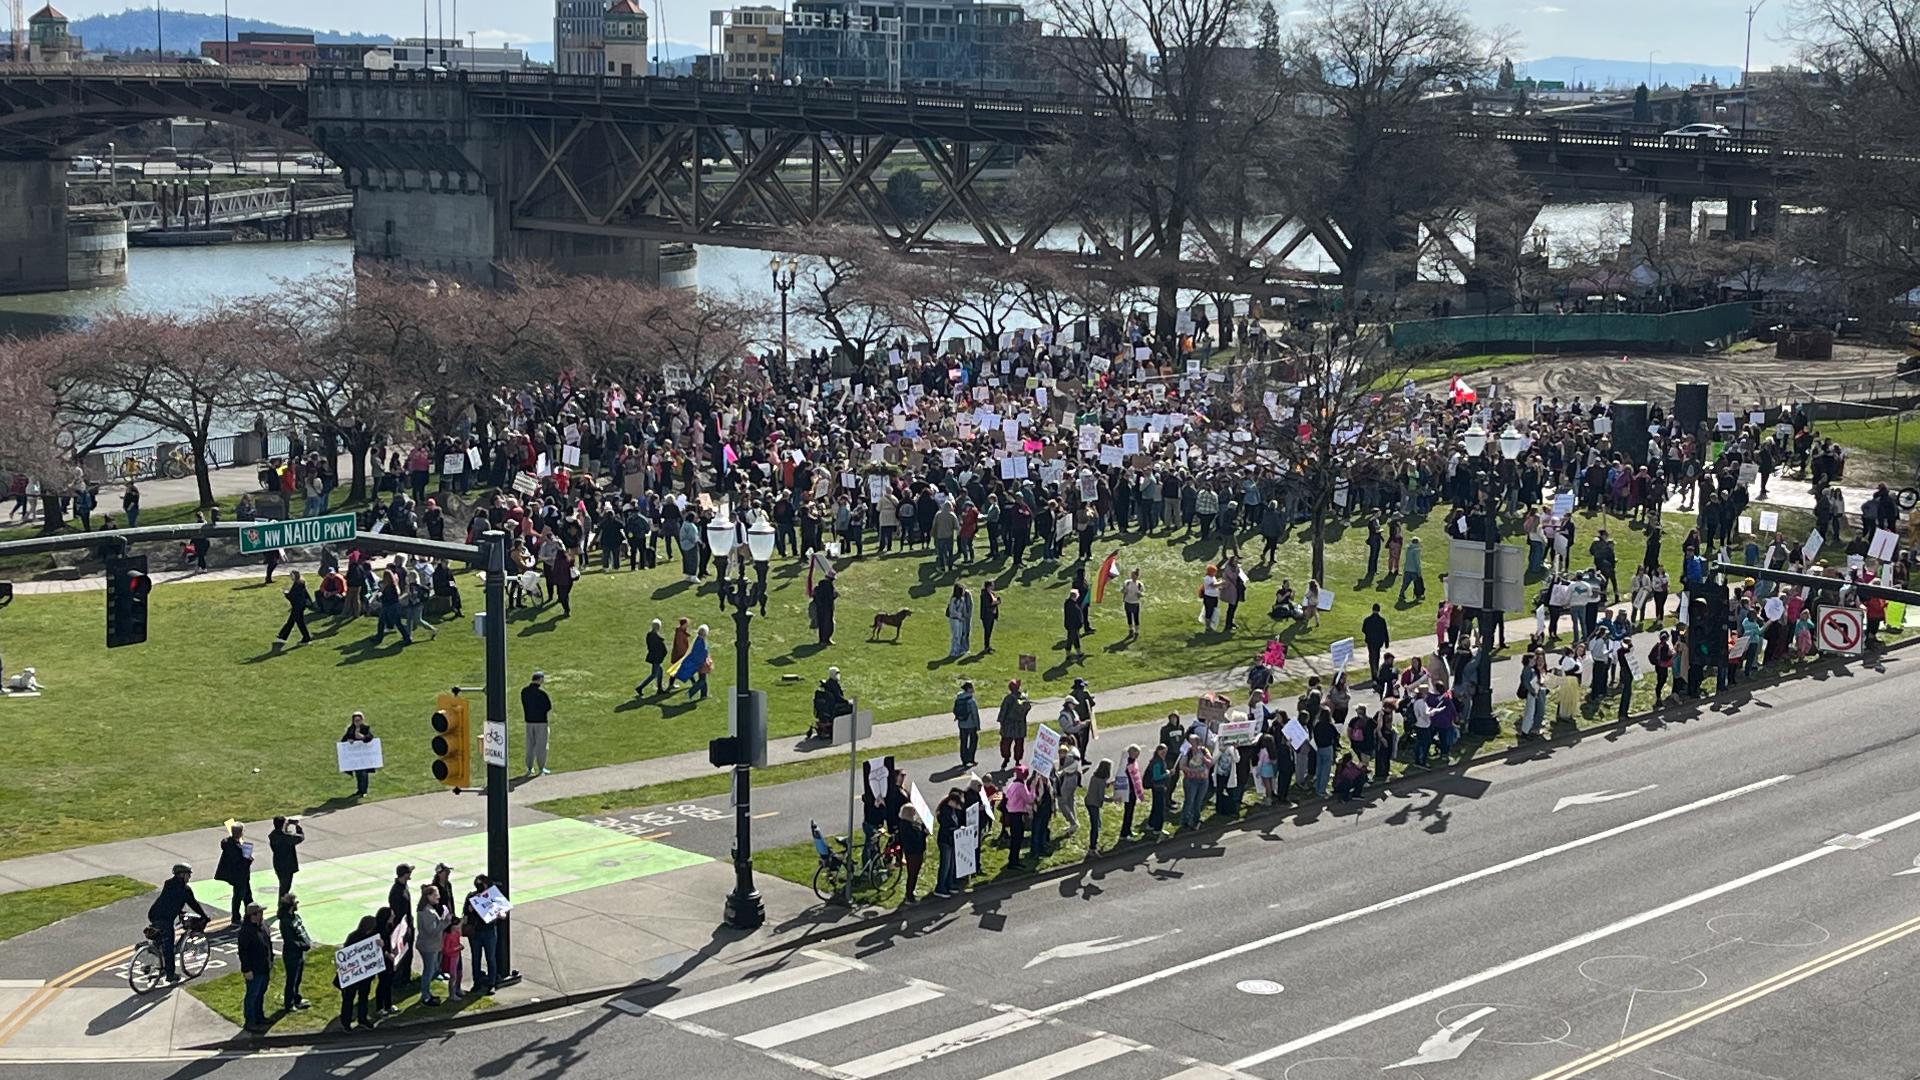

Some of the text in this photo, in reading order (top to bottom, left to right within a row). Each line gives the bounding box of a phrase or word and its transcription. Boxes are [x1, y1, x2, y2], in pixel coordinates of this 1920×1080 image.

[265, 521, 352, 547] NW NAITO PKWY
[485, 748, 503, 759] SIGNAL
